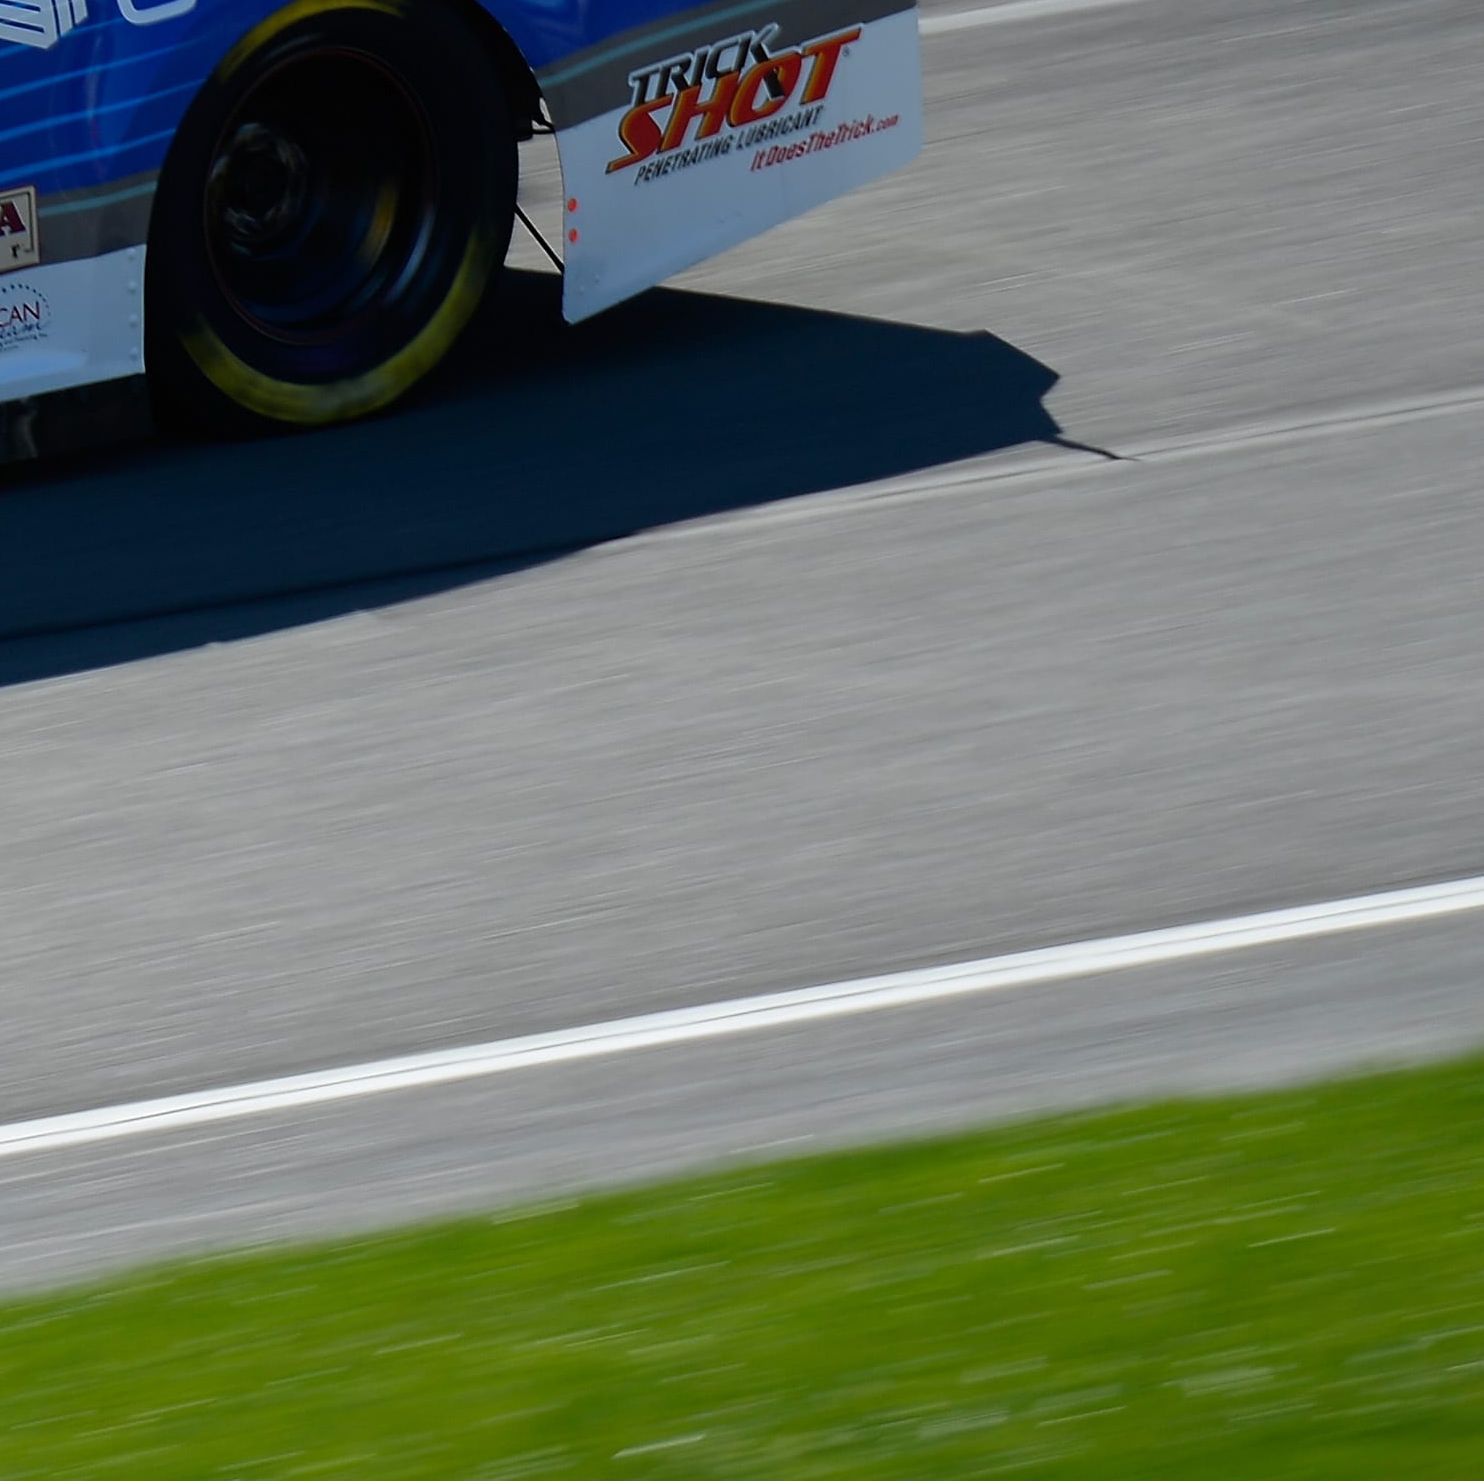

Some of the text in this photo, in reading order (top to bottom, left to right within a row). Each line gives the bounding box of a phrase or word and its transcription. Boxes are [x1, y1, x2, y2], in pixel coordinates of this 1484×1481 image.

[605, 23, 865, 174] SHOT
[628, 22, 784, 105] TRICK
[633, 104, 826, 187] PENETRATING LUBRICANT
